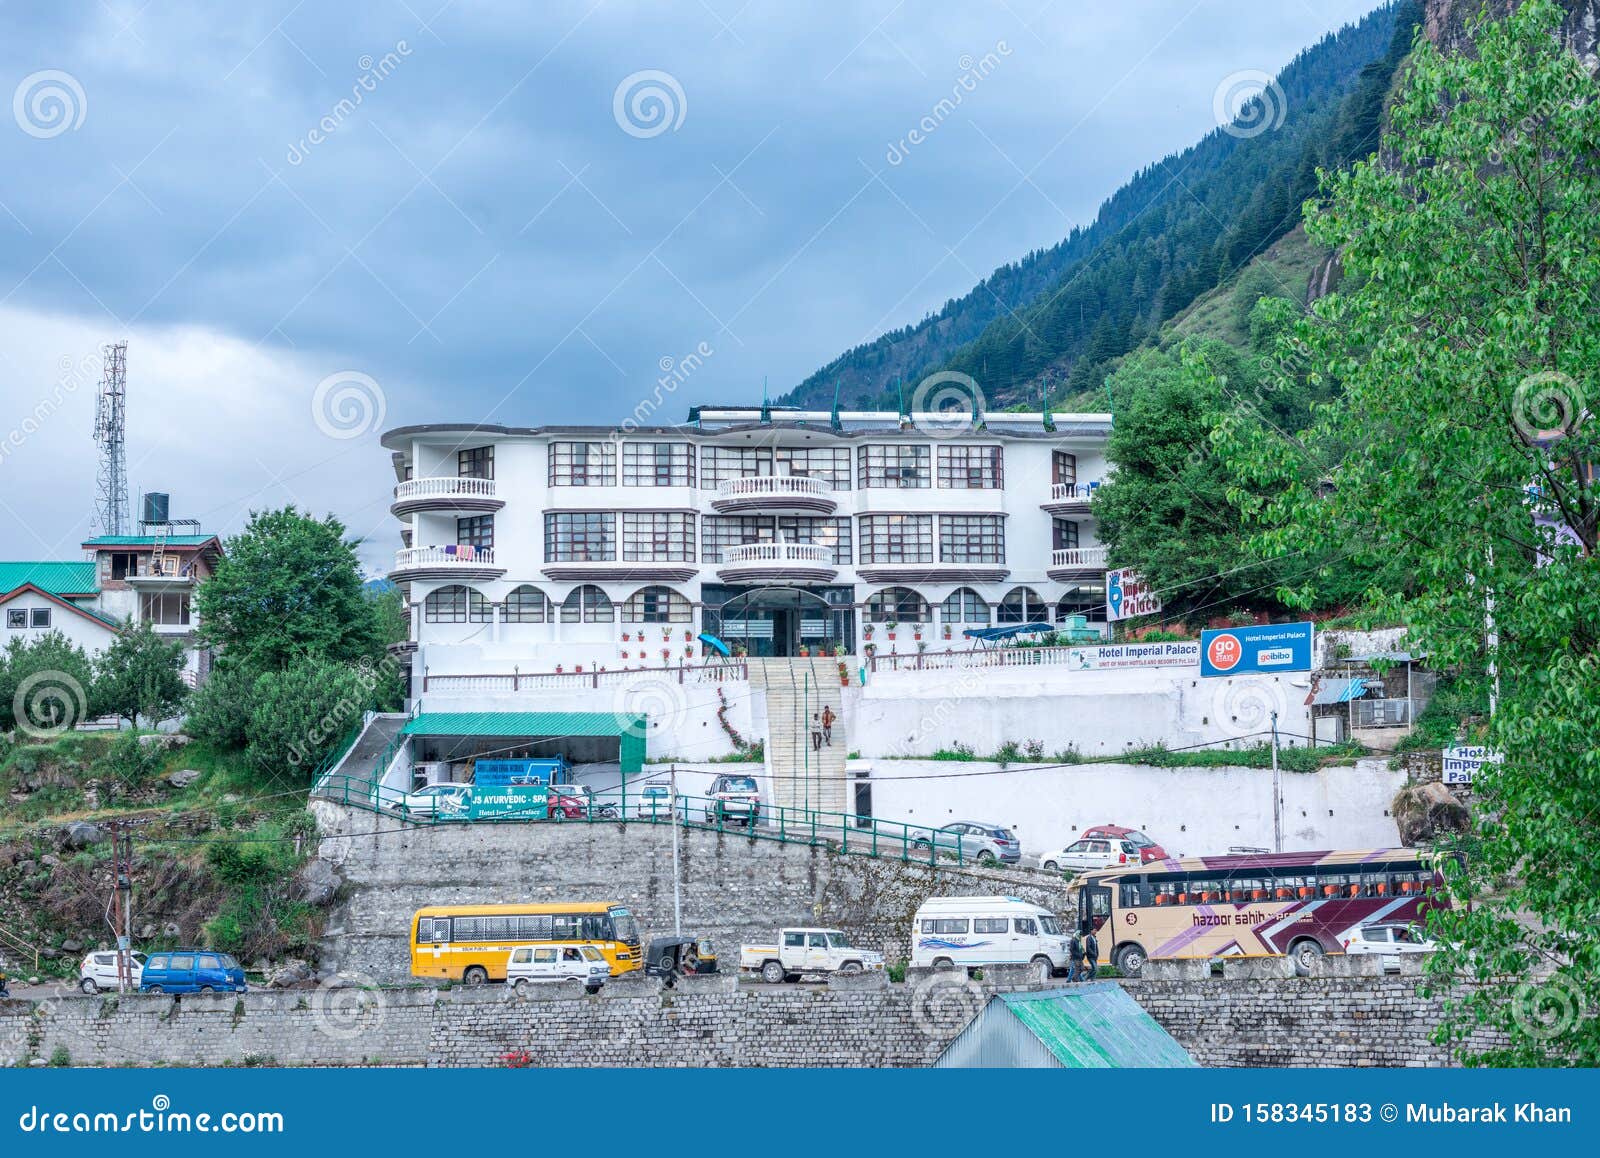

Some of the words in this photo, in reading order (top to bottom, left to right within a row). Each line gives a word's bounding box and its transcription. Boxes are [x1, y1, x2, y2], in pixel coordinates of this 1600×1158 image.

[1286, 631, 1306, 639] Palace
[1098, 647, 1123, 658] Hotel
[1125, 645, 1163, 658] Imperial
[1166, 644, 1197, 655] Palace
[1215, 640, 1235, 655] go
[1260, 652, 1290, 662] goibibo
[1459, 747, 1495, 758] Hotl
[483, 795, 527, 805] AYURVEDIC
[532, 794, 547, 804] SPA
[1192, 912, 1231, 927] hazoor
